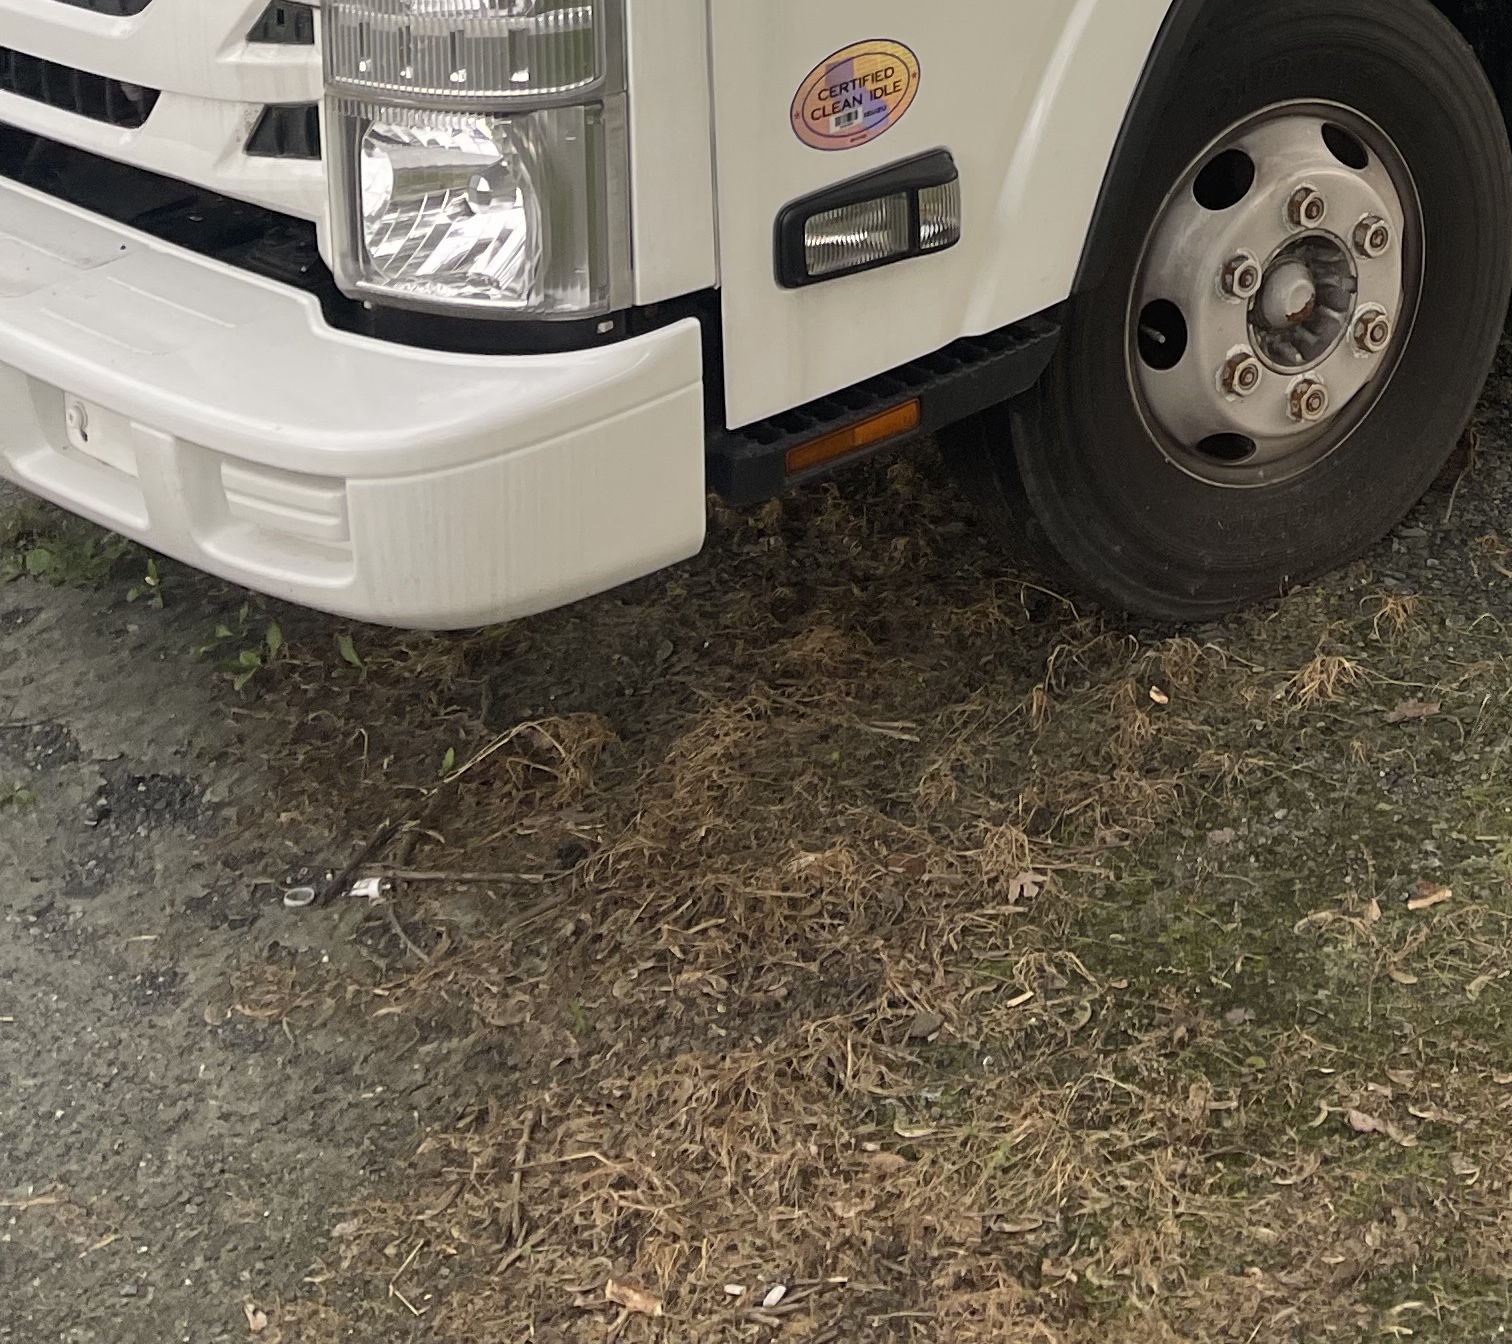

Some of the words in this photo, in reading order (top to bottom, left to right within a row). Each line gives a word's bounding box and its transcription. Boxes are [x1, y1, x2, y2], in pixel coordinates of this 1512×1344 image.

[810, 93, 863, 121] CLEAN
[869, 79, 903, 102] IDLE
[817, 66, 895, 102] CERTIFIED
